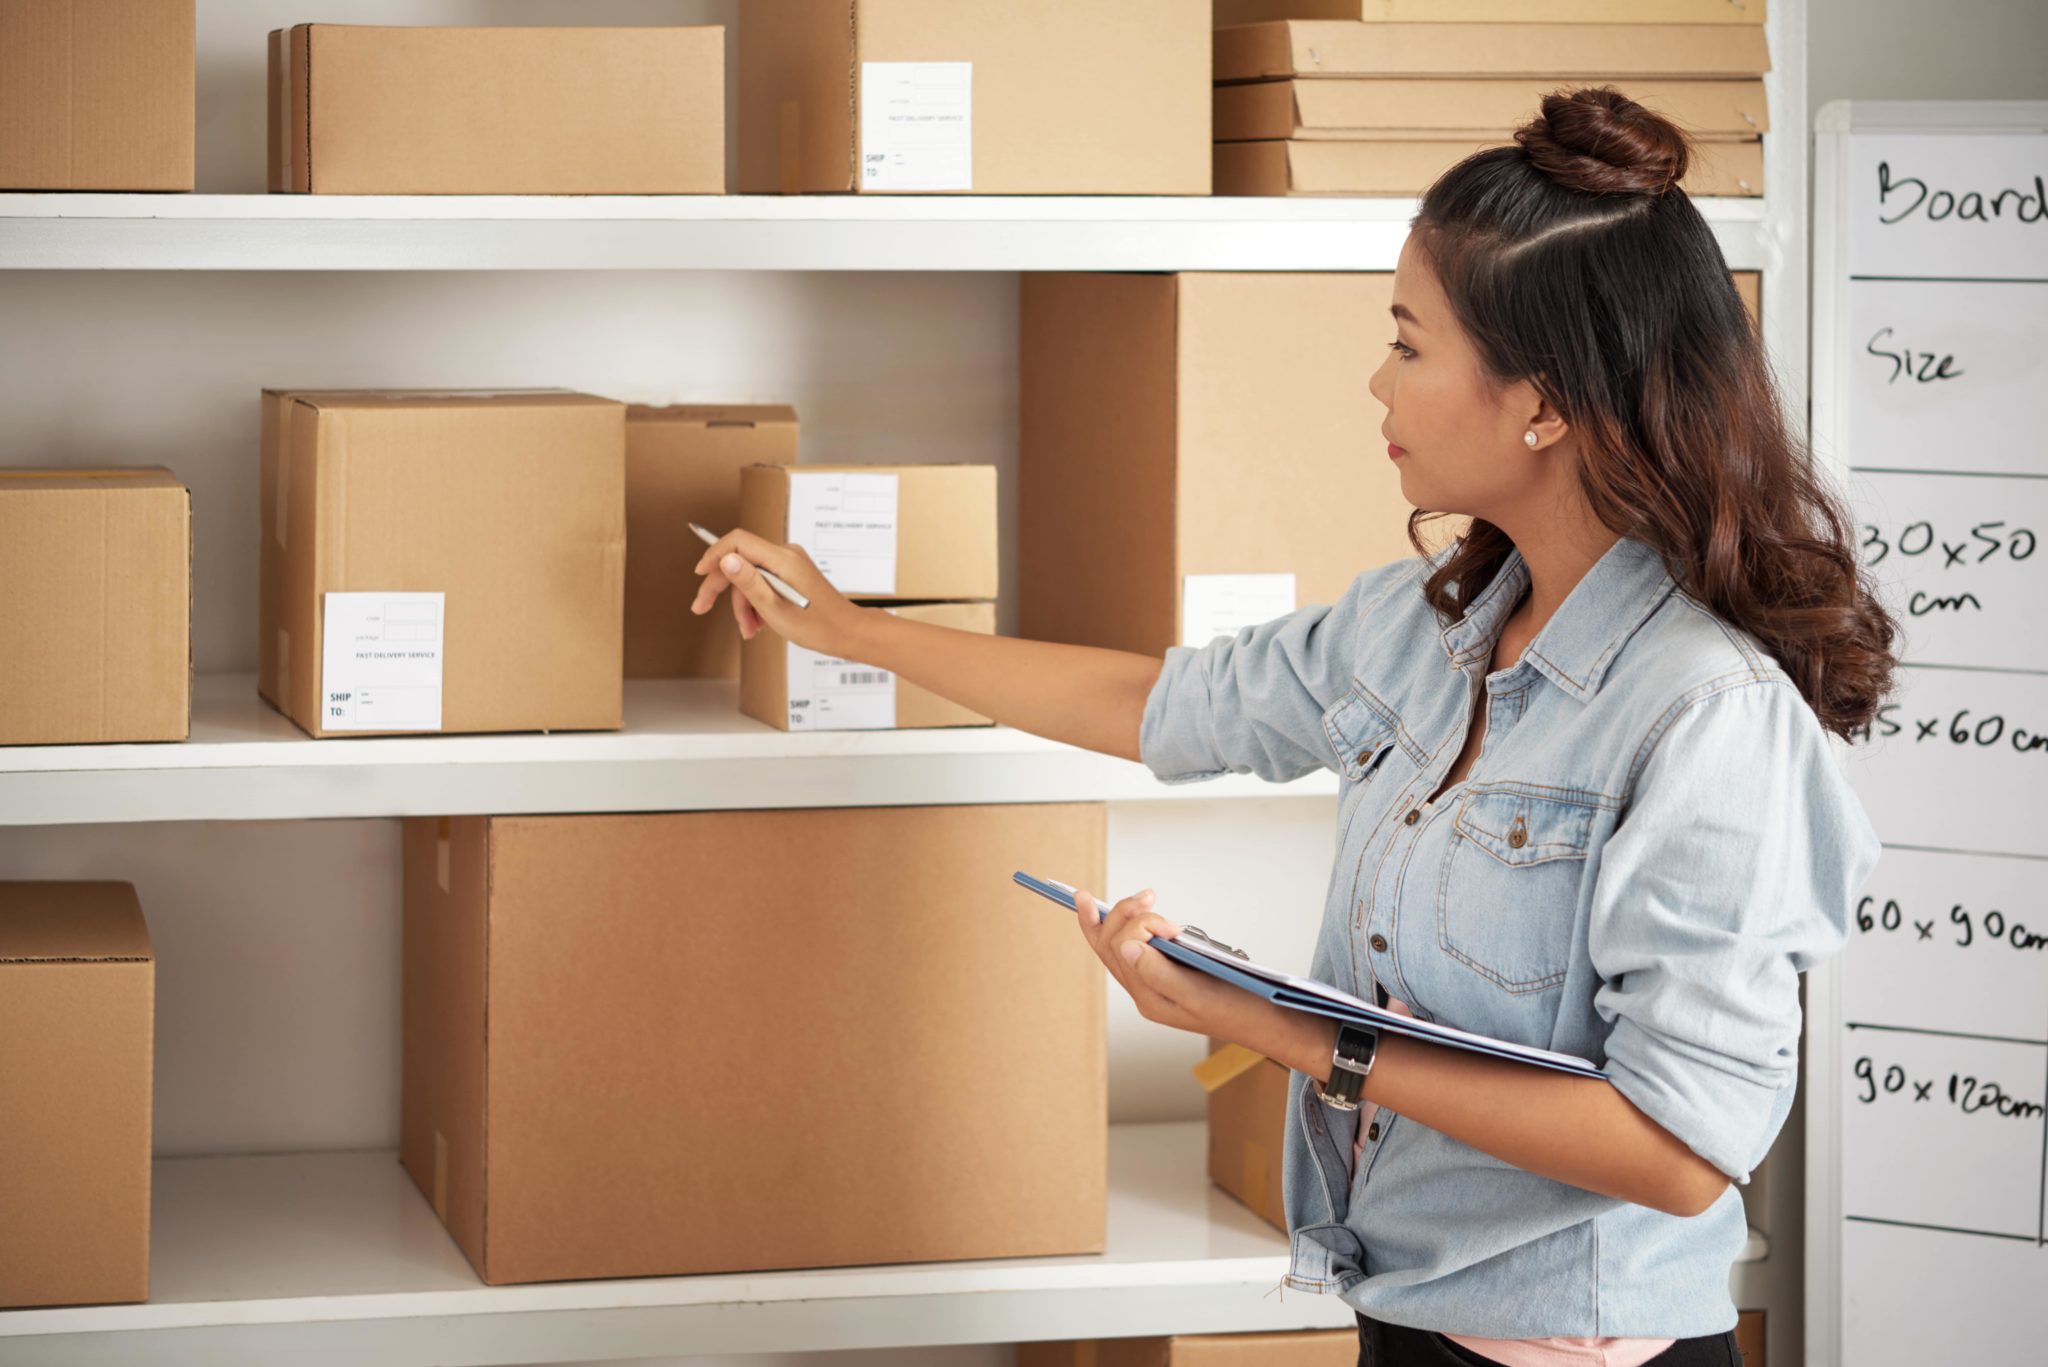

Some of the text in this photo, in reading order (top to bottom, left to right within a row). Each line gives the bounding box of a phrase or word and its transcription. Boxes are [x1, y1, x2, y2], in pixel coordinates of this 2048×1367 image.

[1878, 160, 2048, 224] Board
[1867, 327, 1966, 385] Size
[1909, 590, 1981, 616] cm
[330, 692, 352, 702] SHIP
[790, 699, 810, 709] SHIP
[330, 707, 346, 716] TO:
